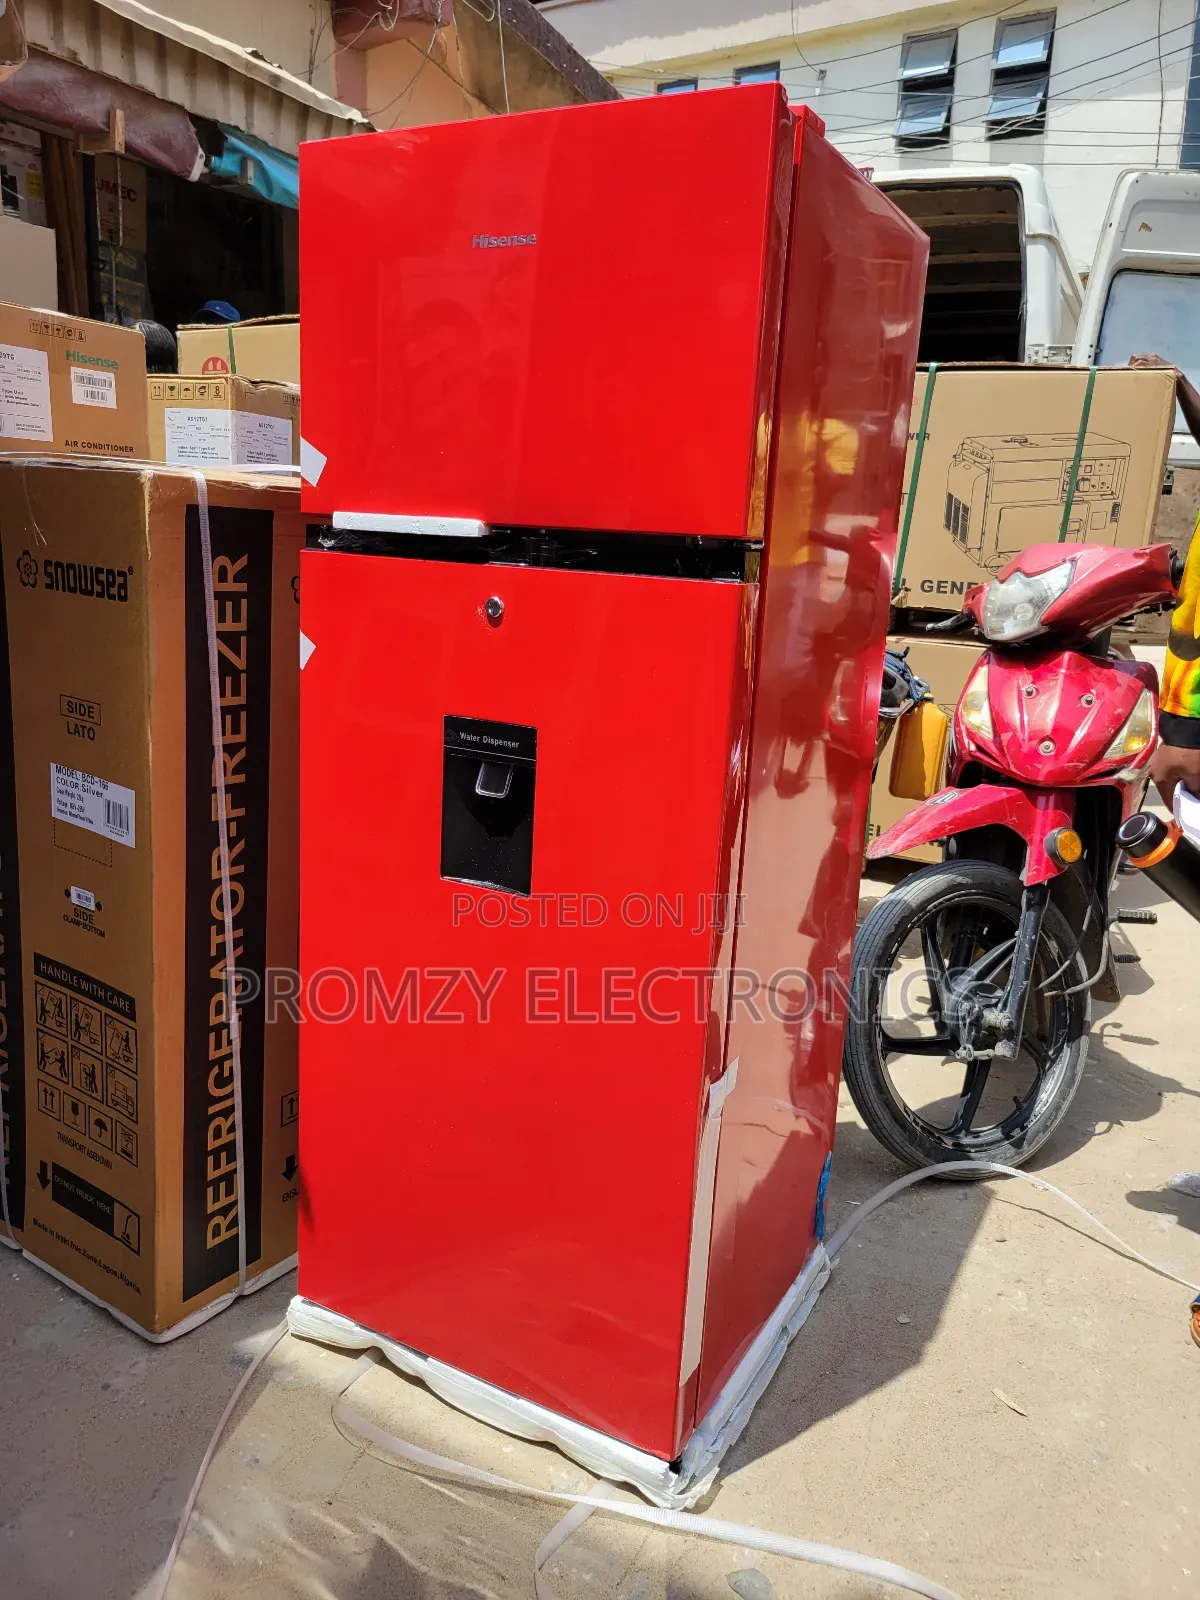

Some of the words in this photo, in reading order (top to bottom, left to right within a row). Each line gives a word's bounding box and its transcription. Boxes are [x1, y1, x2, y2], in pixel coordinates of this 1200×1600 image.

[472, 234, 537, 248] Hisense
[65, 349, 119, 369] Hisense
[64, 439, 79, 448] AIR
[81, 441, 135, 453] CONDITIONER
[67, 700, 95, 719] SIDE
[66, 721, 95, 741] LATO
[459, 731, 480, 743] Water
[482, 735, 519, 749] Dispenser
[55, 764, 81, 781] MODEL:
[73, 908, 95, 925] SIDE
[40, 961, 78, 987] HANDLE
[80, 978, 105, 1000] WITH
[106, 992, 130, 1013] CARE
